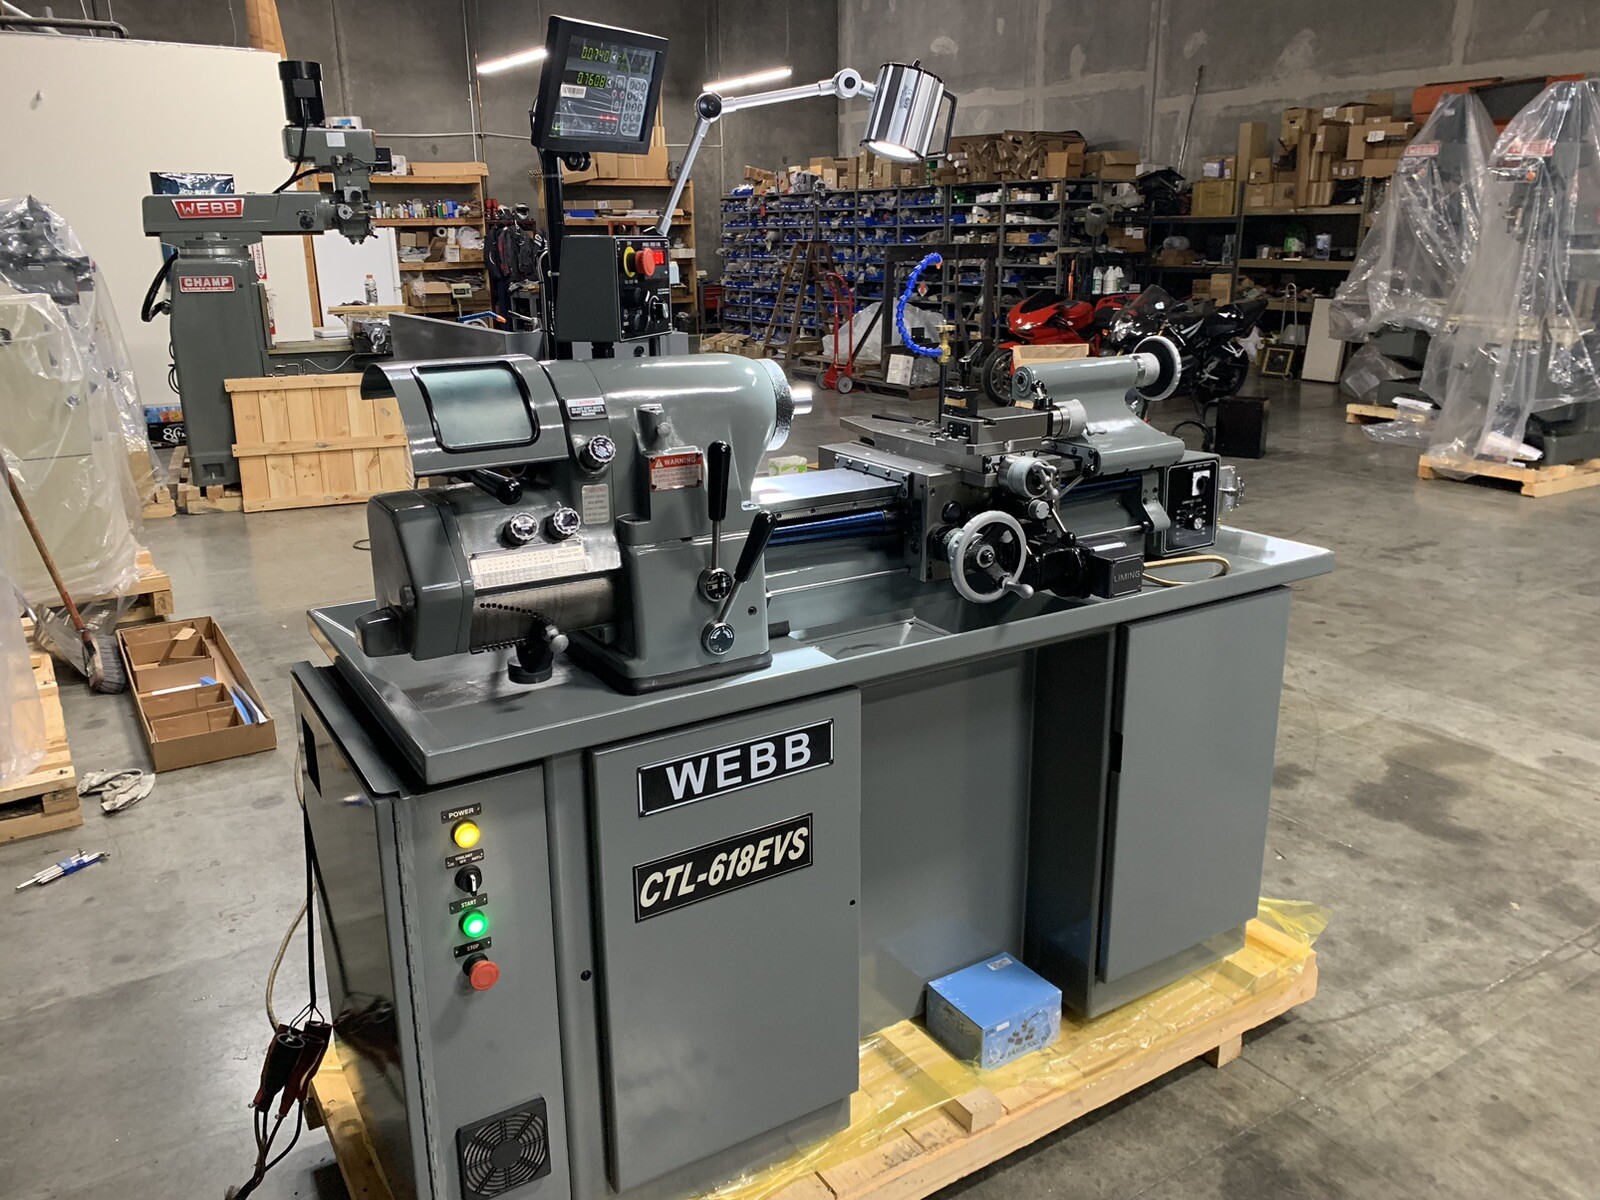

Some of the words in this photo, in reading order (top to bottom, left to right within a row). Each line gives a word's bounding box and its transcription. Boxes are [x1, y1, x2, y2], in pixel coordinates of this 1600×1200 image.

[179, 201, 238, 215] WEBB
[183, 277, 230, 287] CHAMP
[663, 457, 696, 466] WARNING
[1113, 570, 1141, 583] LIMING
[665, 732, 812, 800] WEBB
[448, 807, 475, 819] POWER
[640, 826, 809, 908] CTL-618EVS
[460, 898, 477, 909] START
[466, 943, 480, 952] STOP
